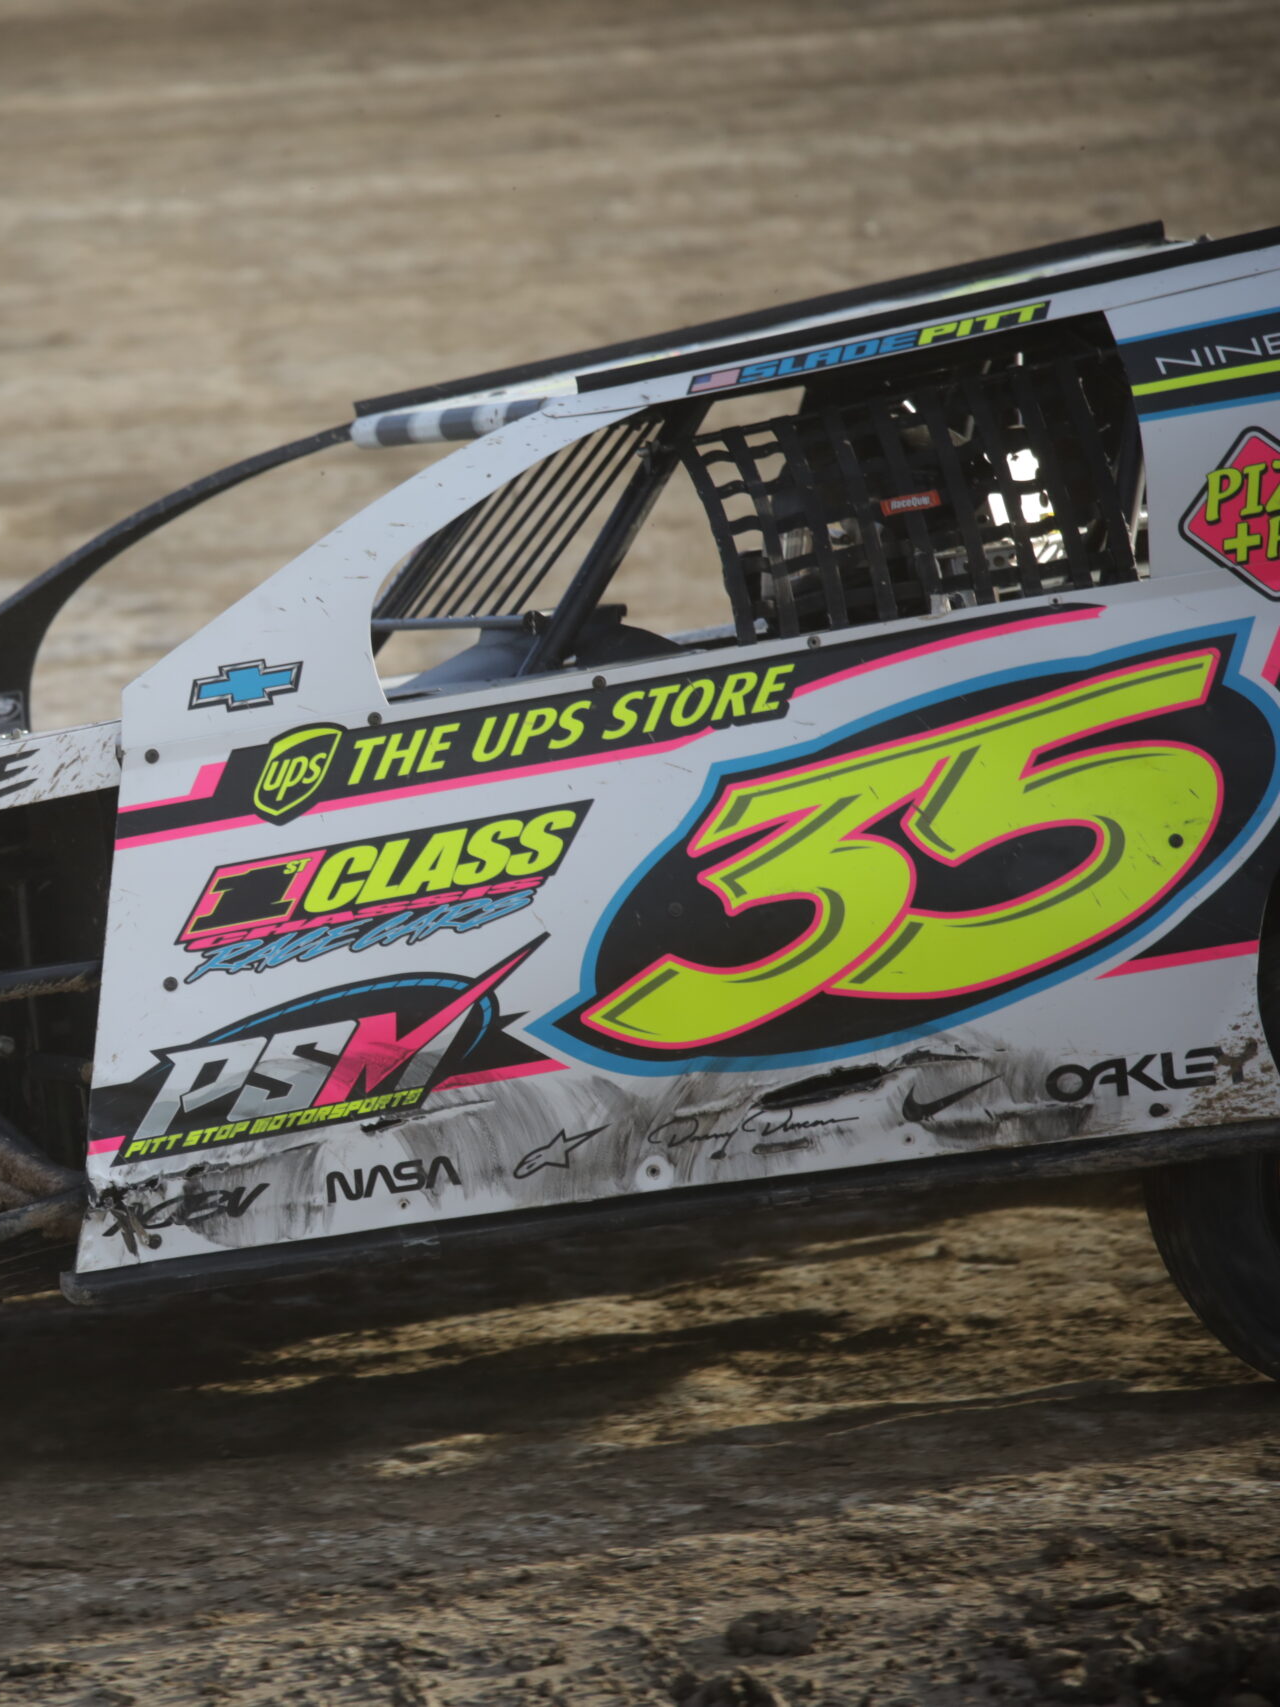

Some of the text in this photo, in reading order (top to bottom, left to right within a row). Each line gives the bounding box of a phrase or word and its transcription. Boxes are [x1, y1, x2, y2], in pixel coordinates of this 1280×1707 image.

[347, 664, 794, 785] THE UPS STORE
[304, 809, 577, 913] CLASS
[581, 648, 1224, 1049] 35
[186, 889, 534, 984] RACE CARS
[187, 876, 544, 951] CHASSIS
[133, 948, 530, 1140] PSM
[1045, 1036, 1259, 1103] OAKLEY
[124, 1088, 425, 1158] PITT STOP MOTORSPORTS
[326, 1156, 461, 1204] NASA
